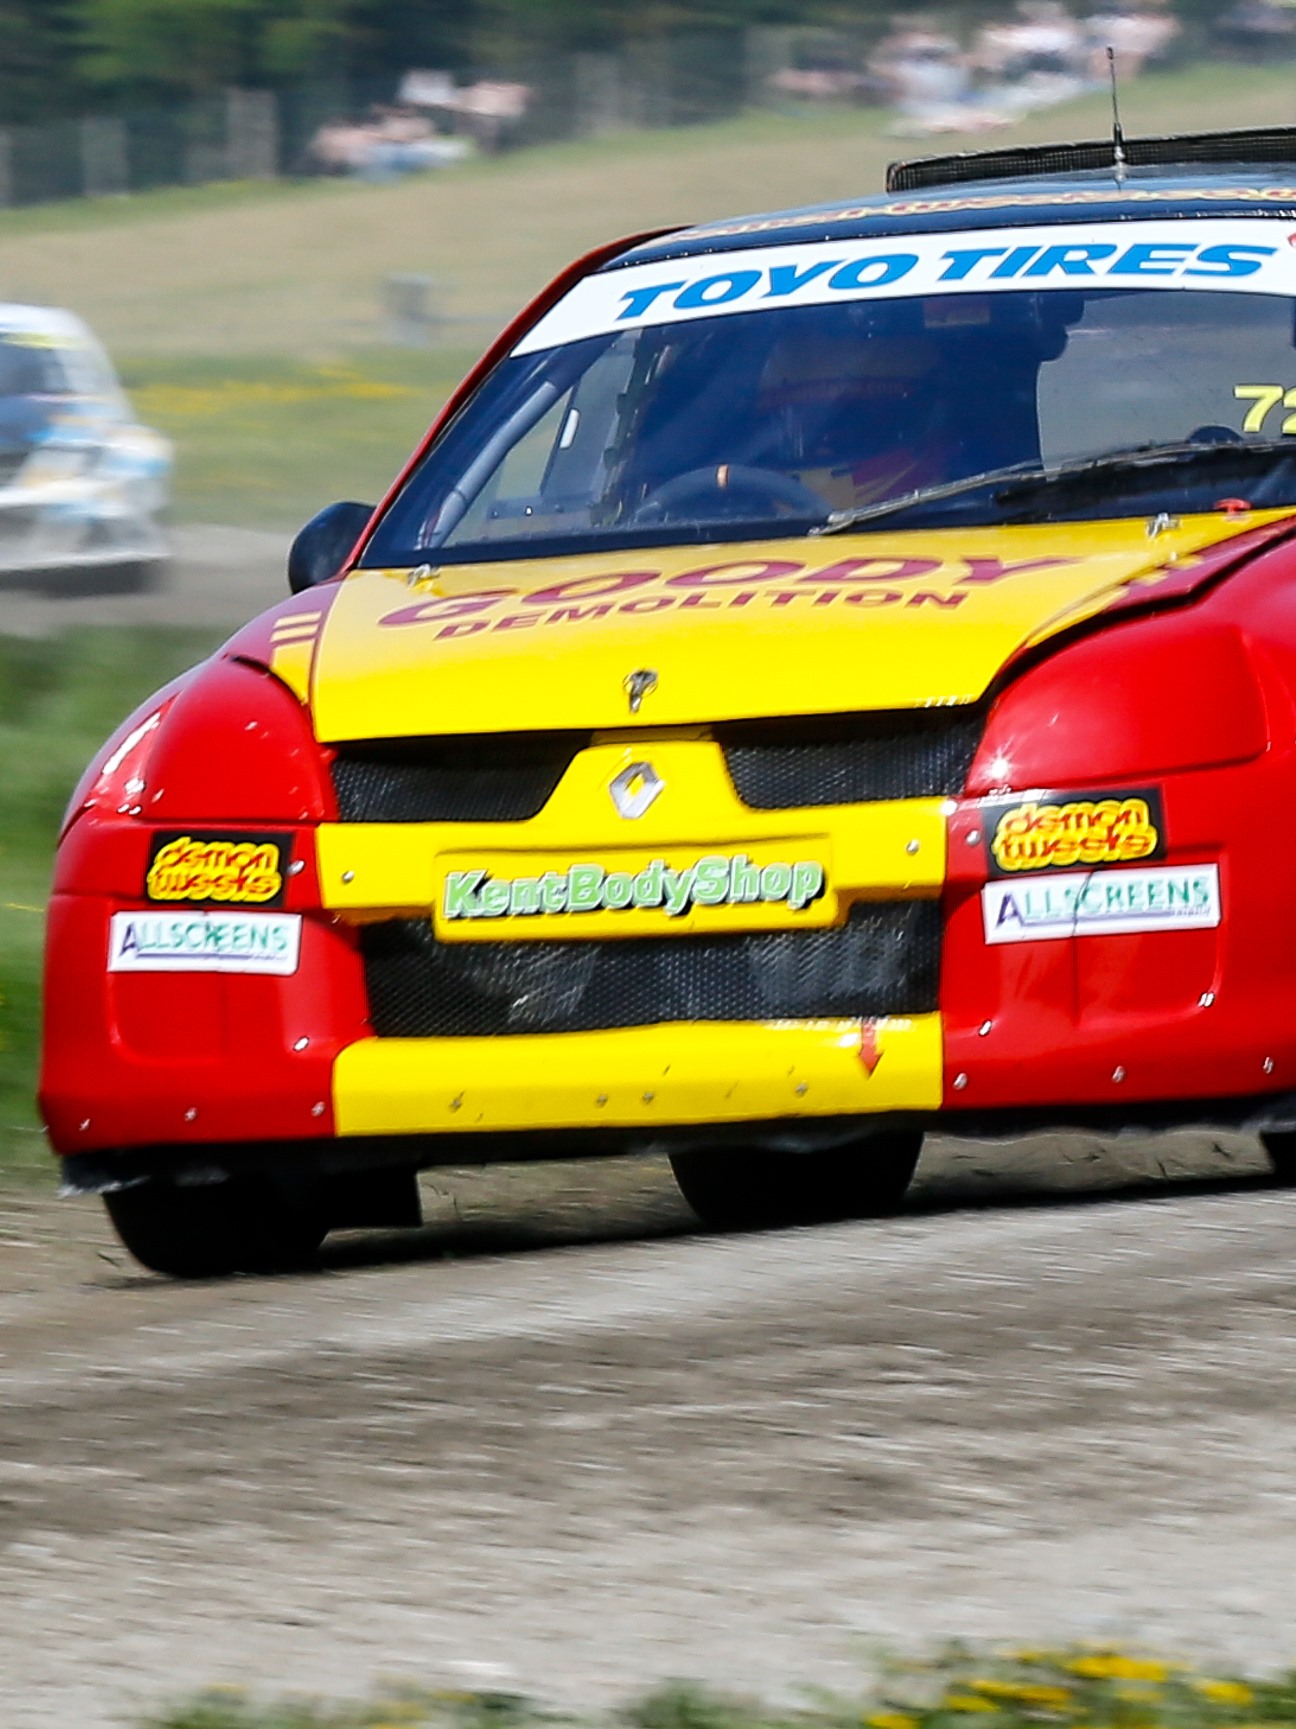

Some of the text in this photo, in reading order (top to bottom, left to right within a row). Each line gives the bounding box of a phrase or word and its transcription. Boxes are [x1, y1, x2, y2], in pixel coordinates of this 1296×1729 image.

[617, 241, 1280, 321] TOYO TIRES
[378, 556, 1084, 628] GOODY
[433, 588, 968, 641] DEMOLITION
[443, 853, 828, 918] KentBodyShop
[996, 876, 1210, 928] ALLSCREENS
[119, 920, 288, 957] ALLSCREENS
